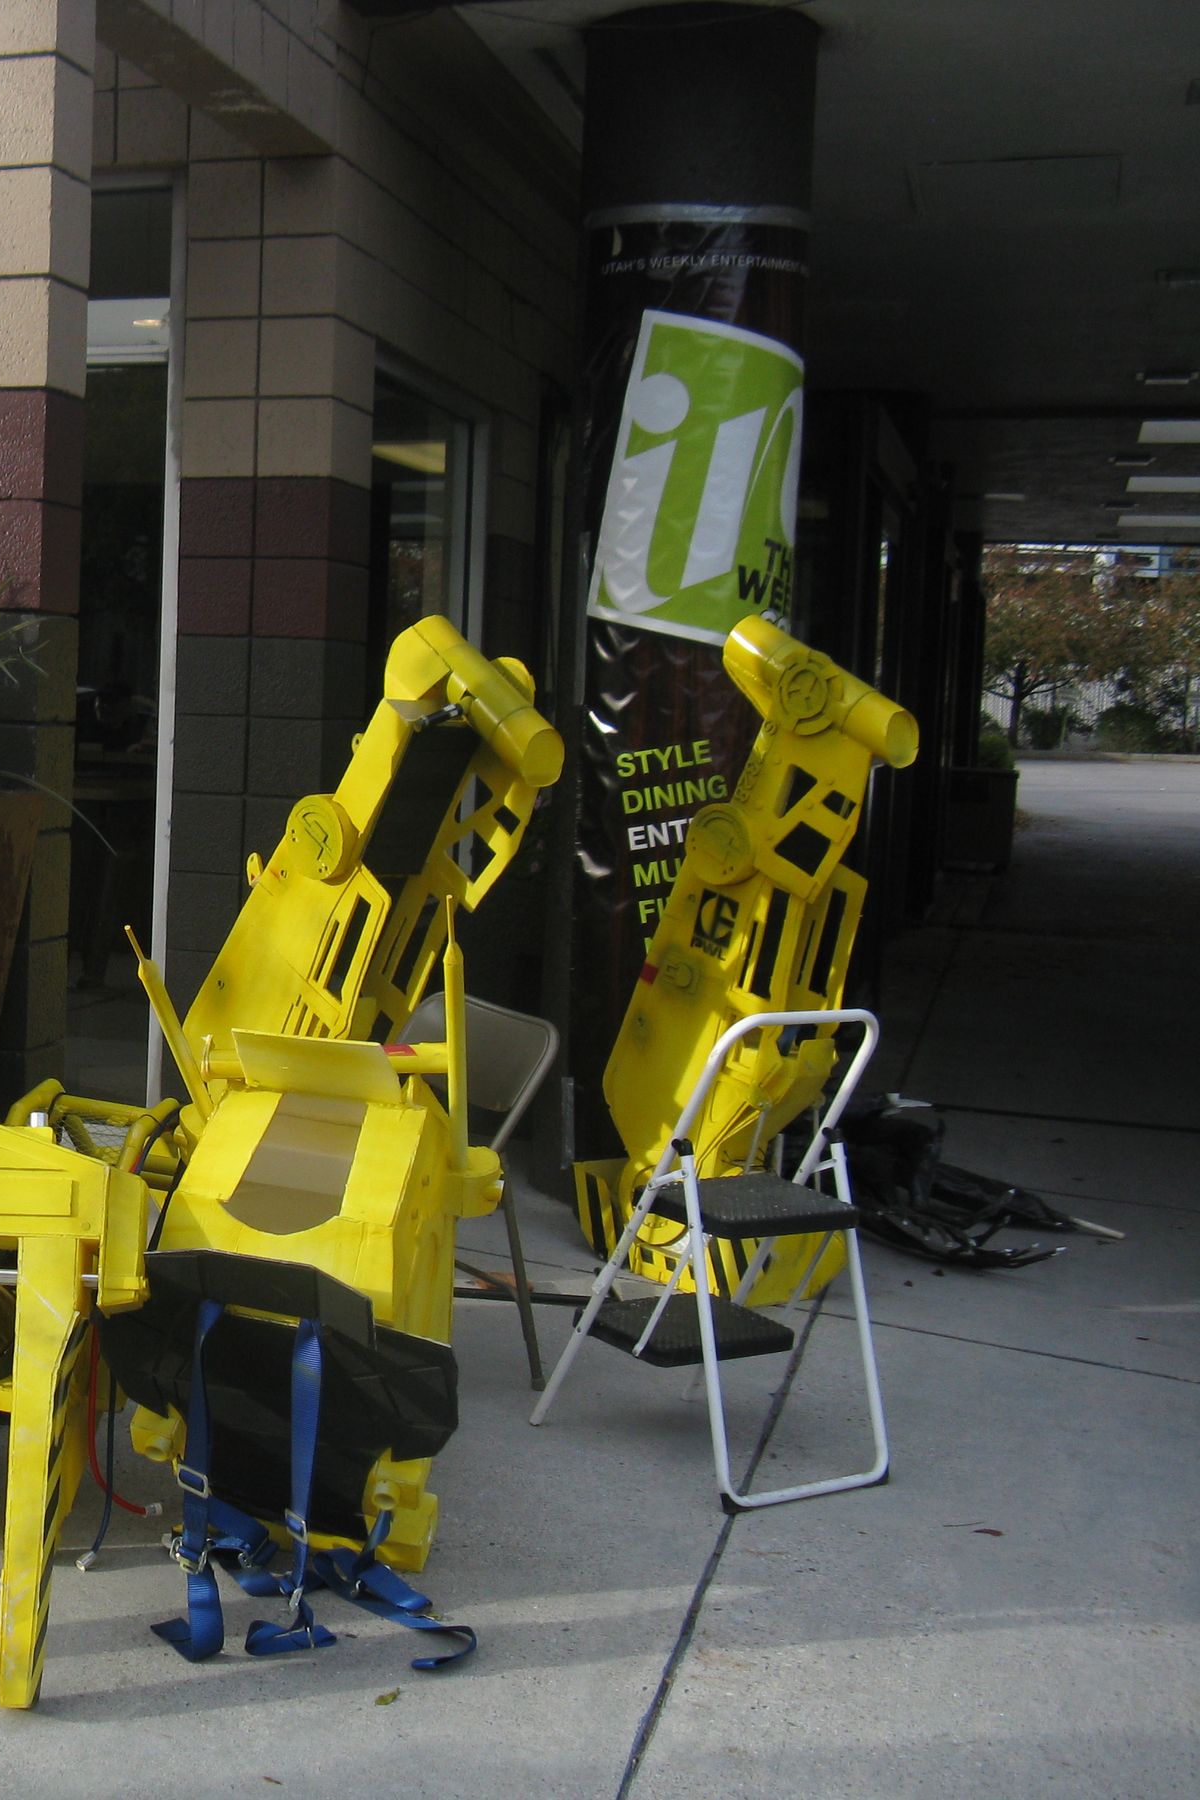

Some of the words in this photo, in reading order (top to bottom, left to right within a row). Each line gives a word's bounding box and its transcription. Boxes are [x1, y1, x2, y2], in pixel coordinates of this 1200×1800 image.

[601, 258, 645, 275] UTAH'S
[649, 254, 706, 270] WEEKLY
[616, 739, 712, 778] STYLE
[622, 774, 728, 814] DINING
[627, 817, 693, 851] ENT
[638, 896, 670, 924] FI
